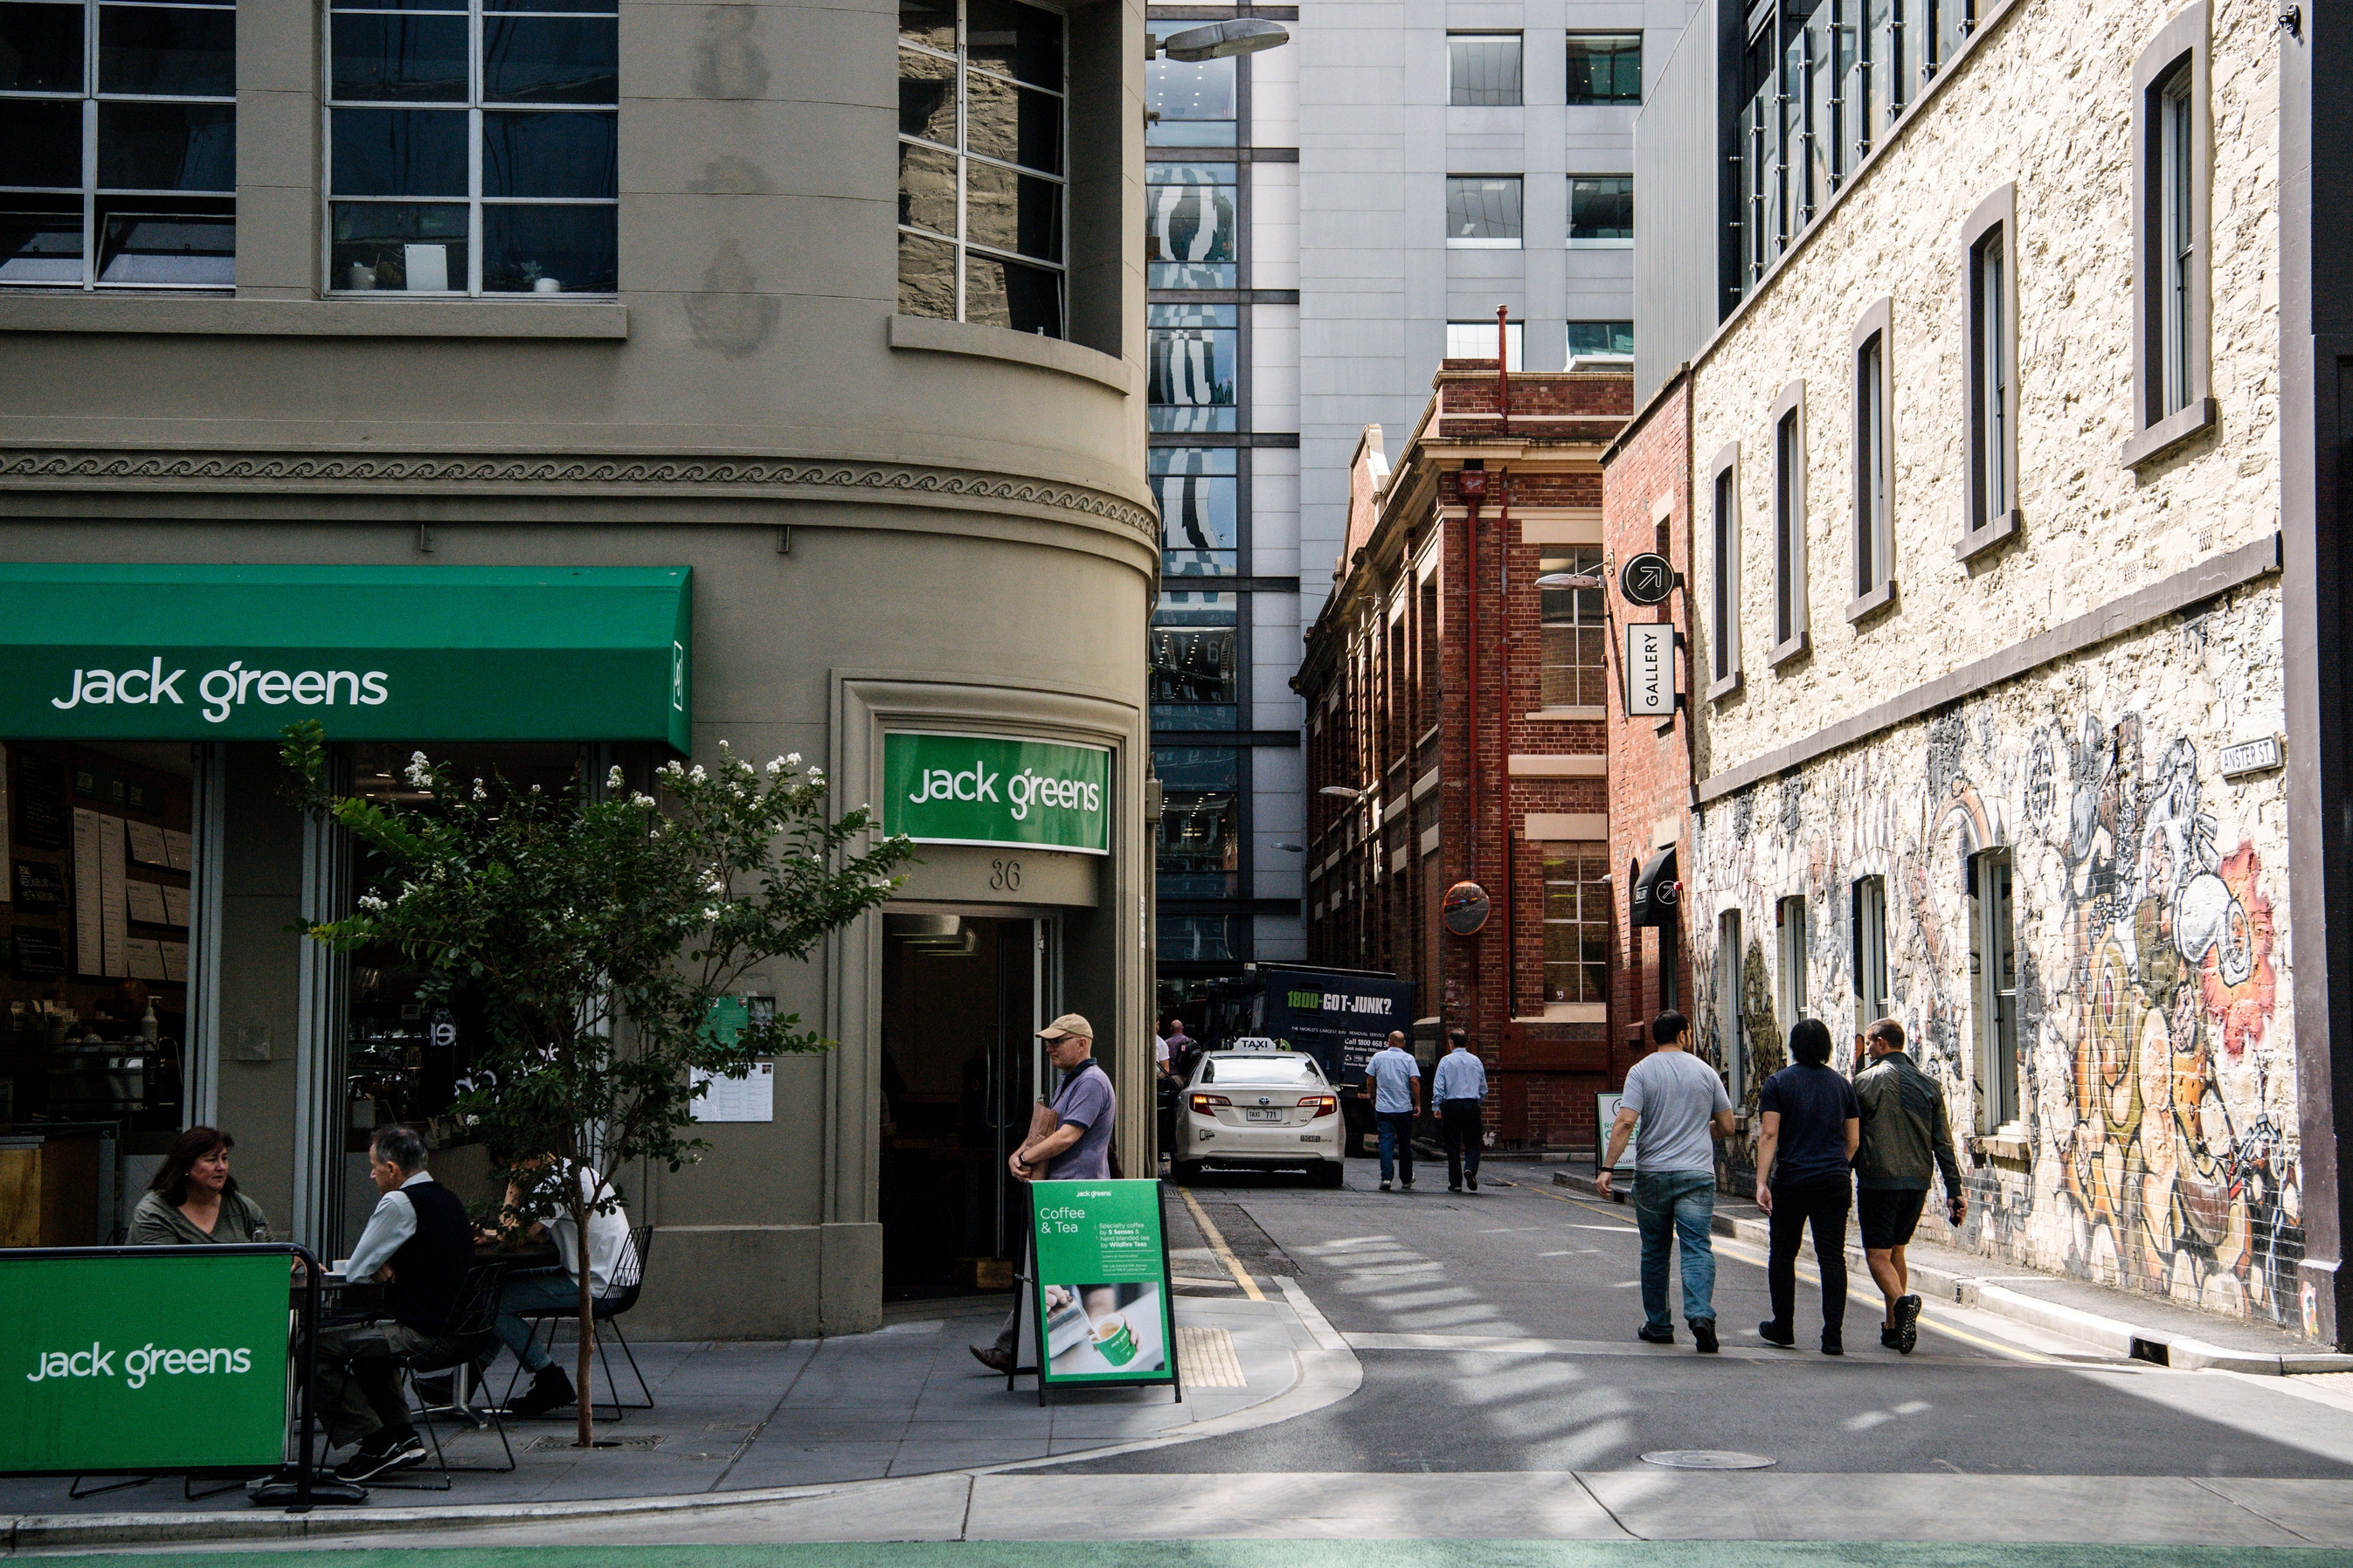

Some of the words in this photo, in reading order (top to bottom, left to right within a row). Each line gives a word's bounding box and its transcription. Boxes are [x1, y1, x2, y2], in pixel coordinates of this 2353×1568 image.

[1644, 633, 1658, 707] GALLERY
[199, 661, 389, 723] greens
[2224, 746, 2257, 770] ANSTER
[1007, 768, 1099, 821] greens
[989, 860, 1021, 891] 36
[1265, 1110, 1277, 1119] 771
[1090, 1190, 1111, 1198] greens
[1040, 1206, 1085, 1219] Coffee
[1042, 1221, 1051, 1233] &
[1055, 1221, 1078, 1233] Tea
[125, 1343, 253, 1389] greens
